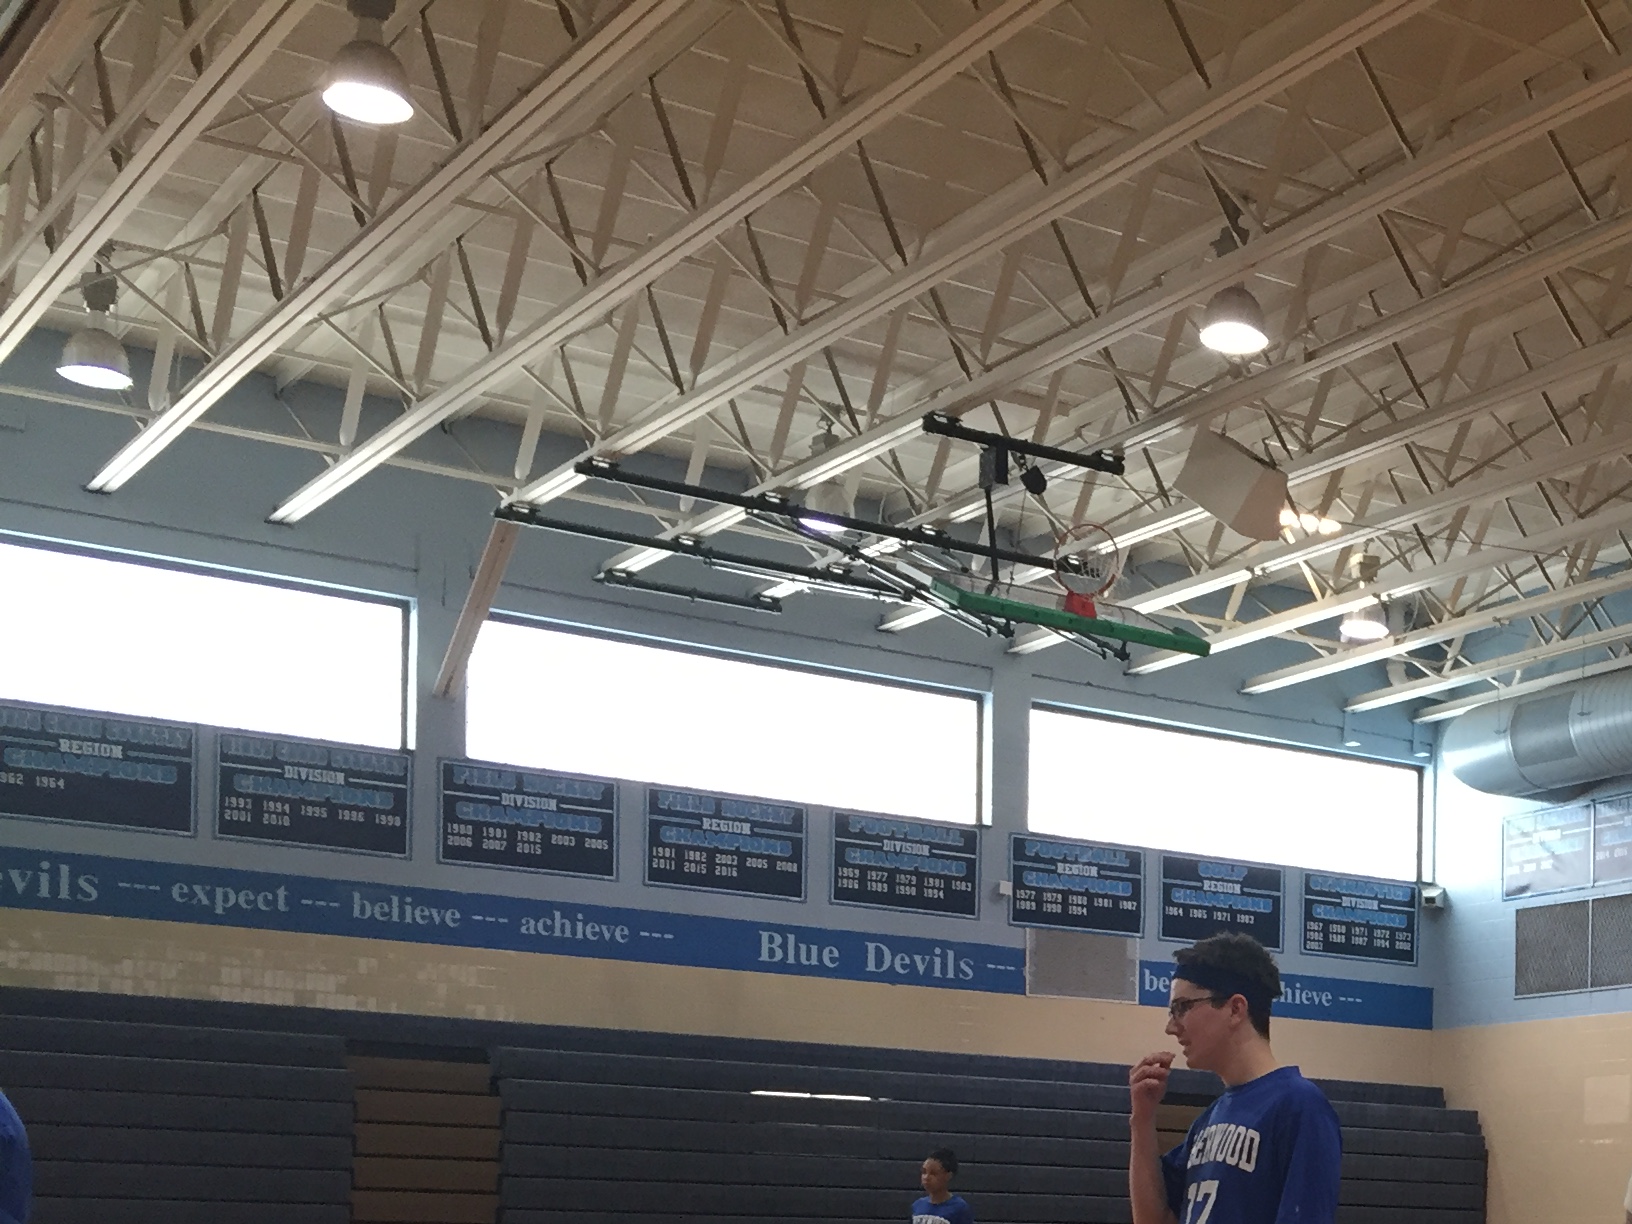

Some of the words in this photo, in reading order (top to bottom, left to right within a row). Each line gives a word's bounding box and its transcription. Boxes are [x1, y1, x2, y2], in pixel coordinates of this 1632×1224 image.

[58, 738, 123, 759] REGION
[36, 775, 65, 790] 1964
[284, 765, 345, 785] DIVISION
[263, 800, 290, 814] 1994
[301, 805, 328, 818] 1995
[501, 793, 557, 811] DIVISION
[658, 791, 715, 815] FIELD
[224, 809, 251, 822] 2001
[456, 801, 602, 834] CHAMPIONS
[483, 826, 507, 839] 1981
[517, 830, 542, 843] 1982
[551, 834, 576, 846] 2003
[702, 817, 751, 835] REGION
[848, 815, 965, 847] FOOTBALL
[482, 839, 507, 851] 2007
[517, 842, 542, 855] 2015
[660, 825, 792, 857] CHAMPIONS
[882, 839, 930, 856] DIVISION
[652, 846, 676, 859] 1981
[684, 850, 707, 862] 1982
[715, 853, 738, 866] 2003
[746, 857, 768, 869] 2005
[845, 847, 967, 877] CHAMPIONS
[1024, 840, 1130, 867] FOOTBALL
[652, 858, 676, 871] 2011
[684, 862, 707, 875] 2015
[715, 866, 738, 877] 2016
[838, 866, 860, 879] 1969
[867, 870, 888, 882] 1977
[895, 873, 917, 885] 1979
[924, 877, 945, 889] 1981
[1056, 862, 1098, 877] REGION
[1197, 861, 1248, 881] GOLF
[895, 884, 917, 896] 1990
[923, 888, 945, 900] 1994
[1022, 870, 1133, 897] CHAMPIONS
[1202, 880, 1241, 894] REGION
[1015, 889, 1036, 900] 1977
[1042, 892, 1062, 903] 1979
[1093, 897, 1113, 908] 1981
[1171, 887, 1273, 913] CHAMPIONS
[1341, 896, 1379, 910] DIVISION
[1068, 905, 1087, 916] 1994
[1312, 903, 1407, 928] CHAMPIONS
[0, 861, 99, 902] vils
[171, 881, 290, 915] expect
[352, 891, 461, 928] believe
[520, 910, 630, 944] achieve
[758, 930, 840, 968] Blue
[865, 940, 974, 981] Devils
[1272, 983, 1333, 1007] hieve
